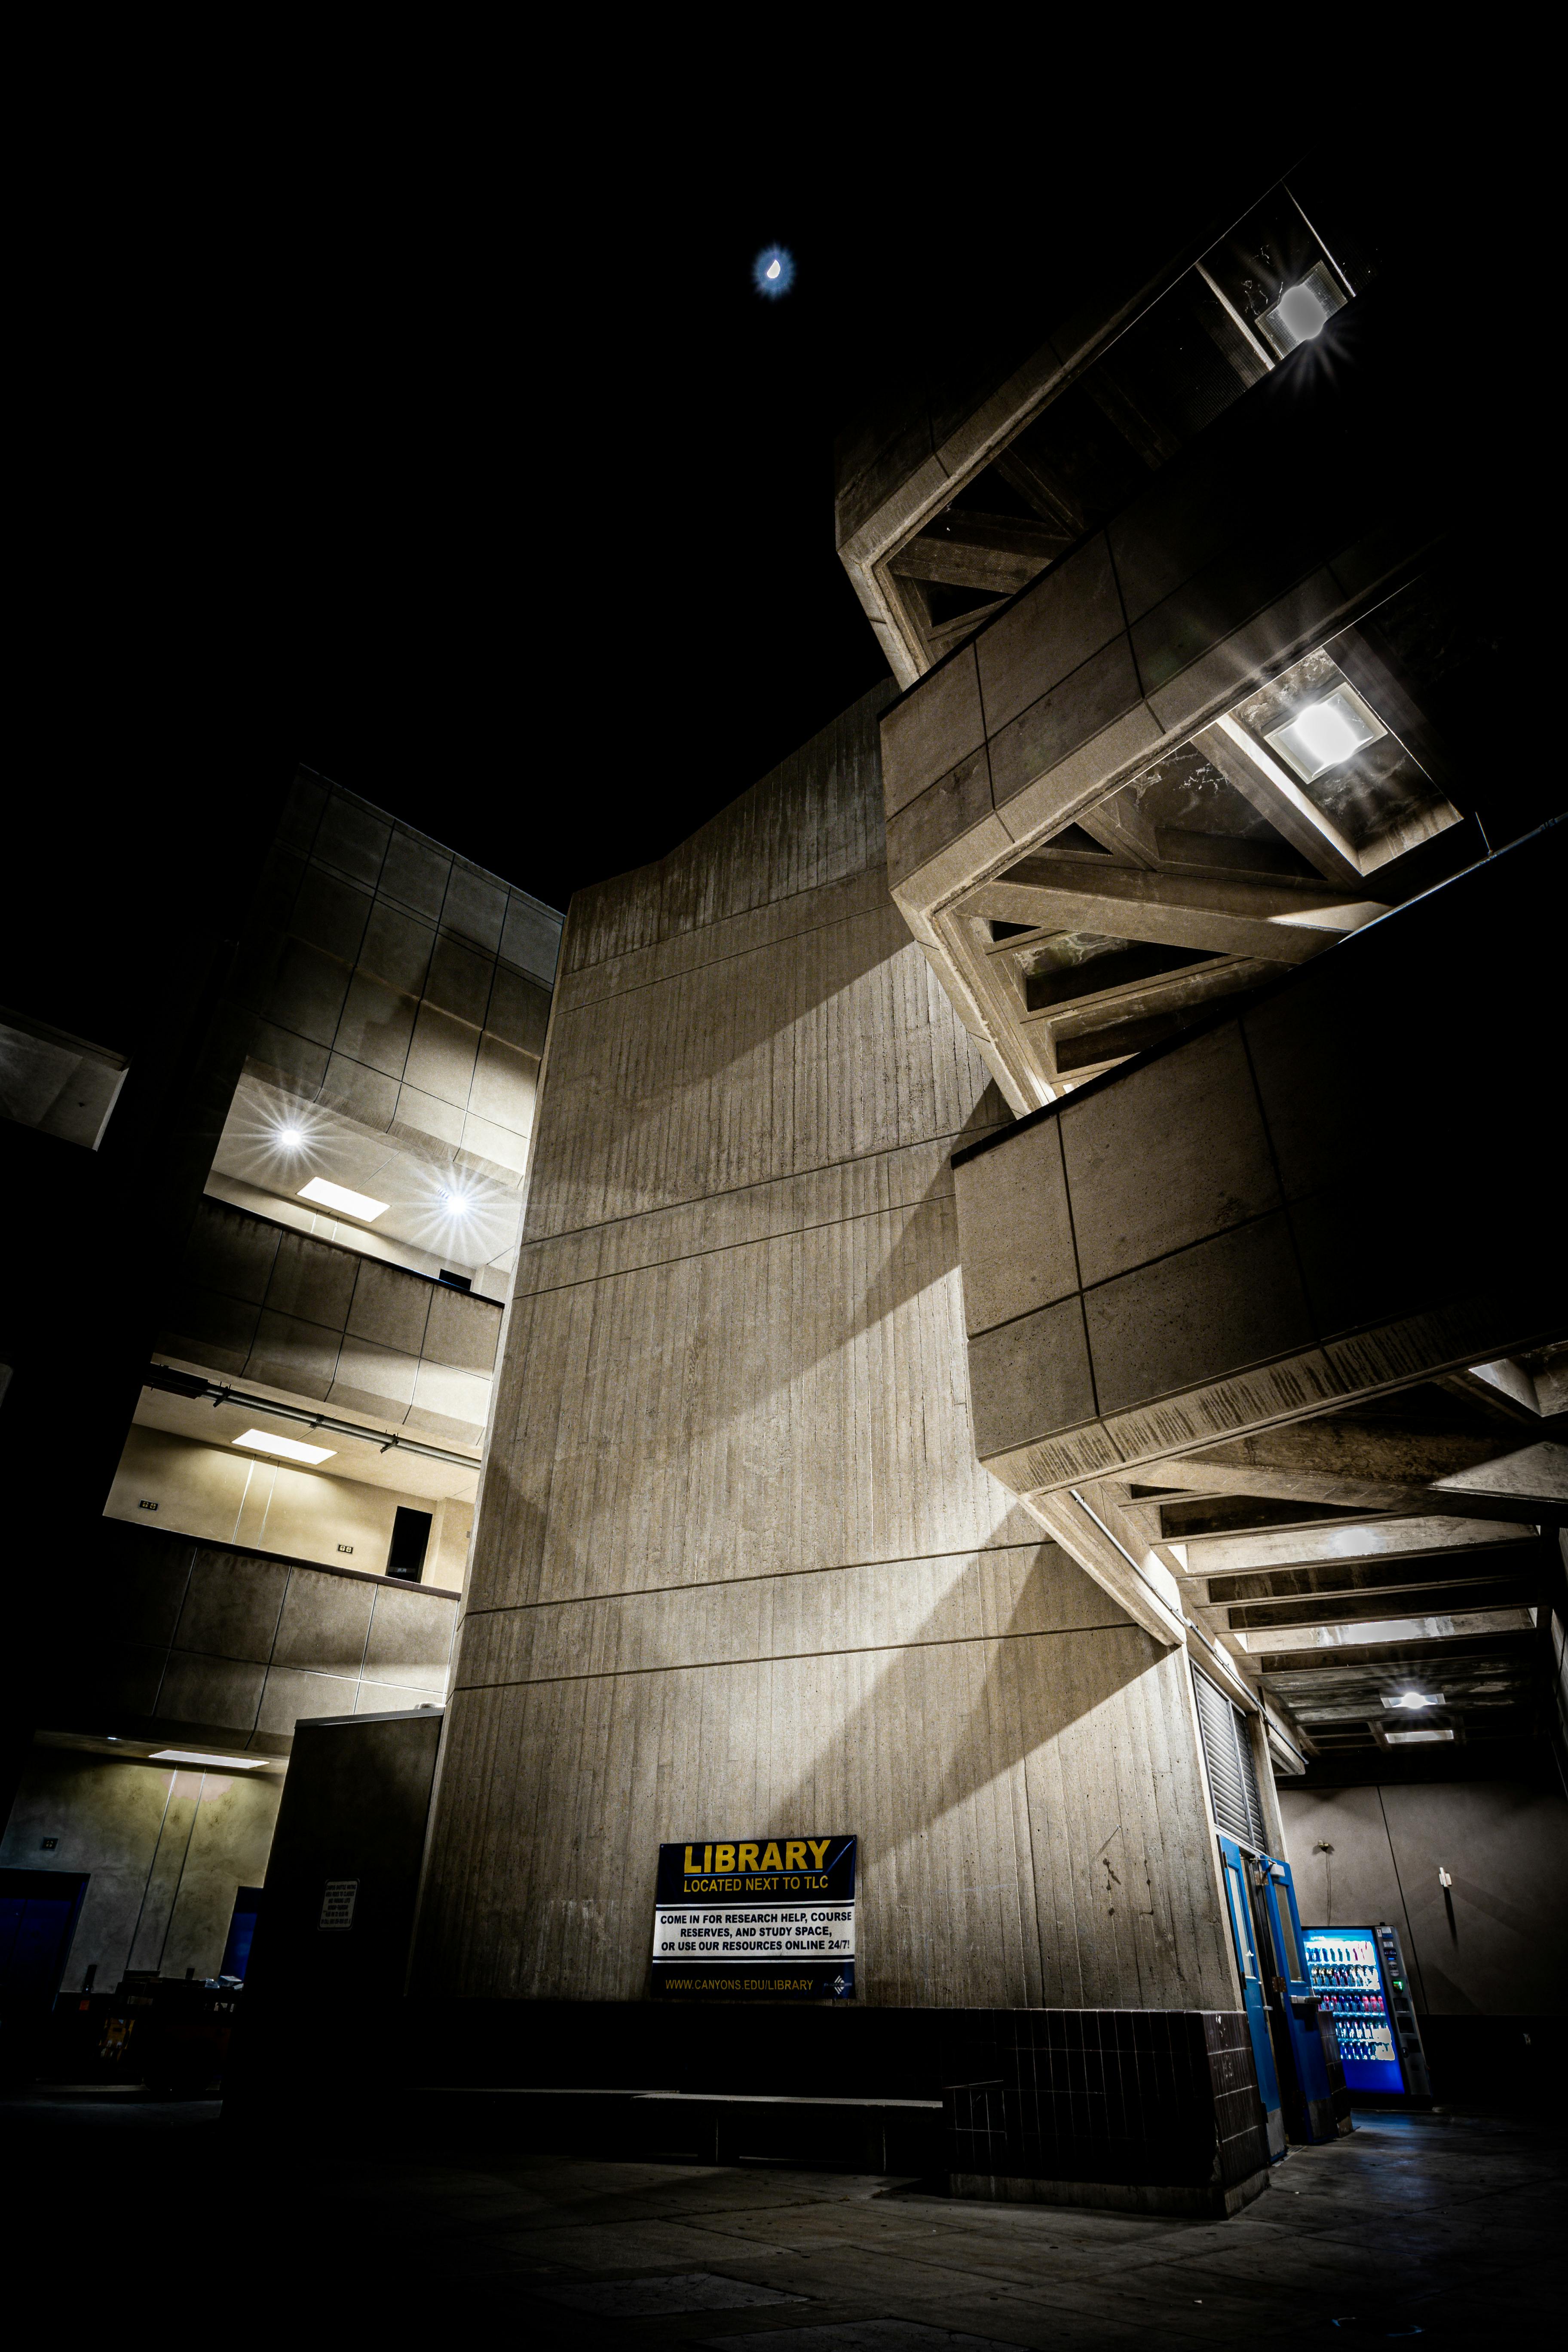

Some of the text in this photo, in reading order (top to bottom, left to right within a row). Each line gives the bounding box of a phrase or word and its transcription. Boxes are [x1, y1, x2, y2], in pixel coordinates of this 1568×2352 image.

[684, 1840, 831, 1873] LIBRARY
[684, 1875, 828, 1892] LOCATED NEXT TO TLC
[661, 1912, 851, 1924] COME IN FOR RESEARCH HELP, COURSE
[680, 1926, 832, 1939] RESERVES, AND STUDY SPACE,
[662, 1939, 850, 1951] OR USE OUR RESOURCES ONLINE 24/7!
[665, 1979, 813, 1991] WWW.CANYONS.EDU/LIBRARY
